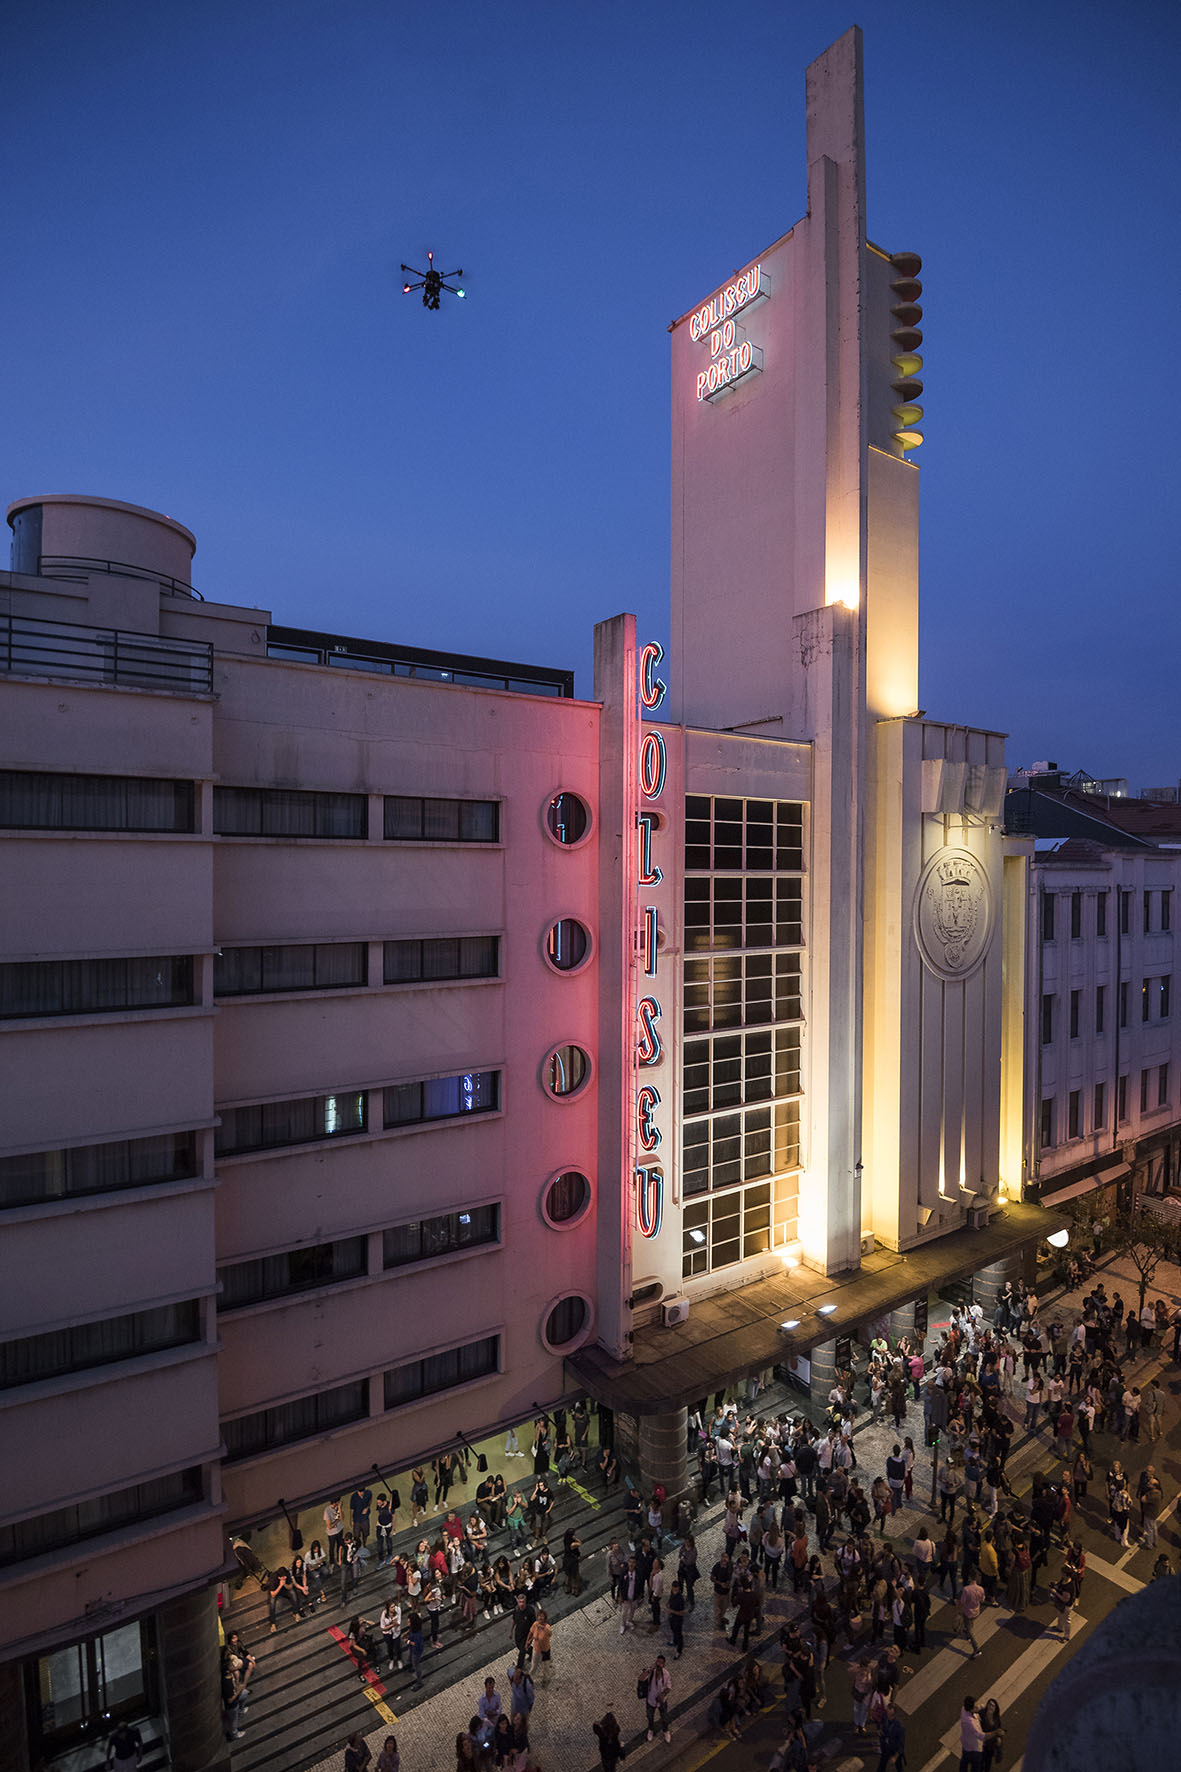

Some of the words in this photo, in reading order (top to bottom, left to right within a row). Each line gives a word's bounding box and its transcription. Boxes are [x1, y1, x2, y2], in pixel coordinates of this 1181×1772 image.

[689, 264, 761, 341] COLISEU
[696, 341, 753, 401] PORTO
[710, 319, 736, 359] DO
[637, 641, 667, 1240] COLISEU
